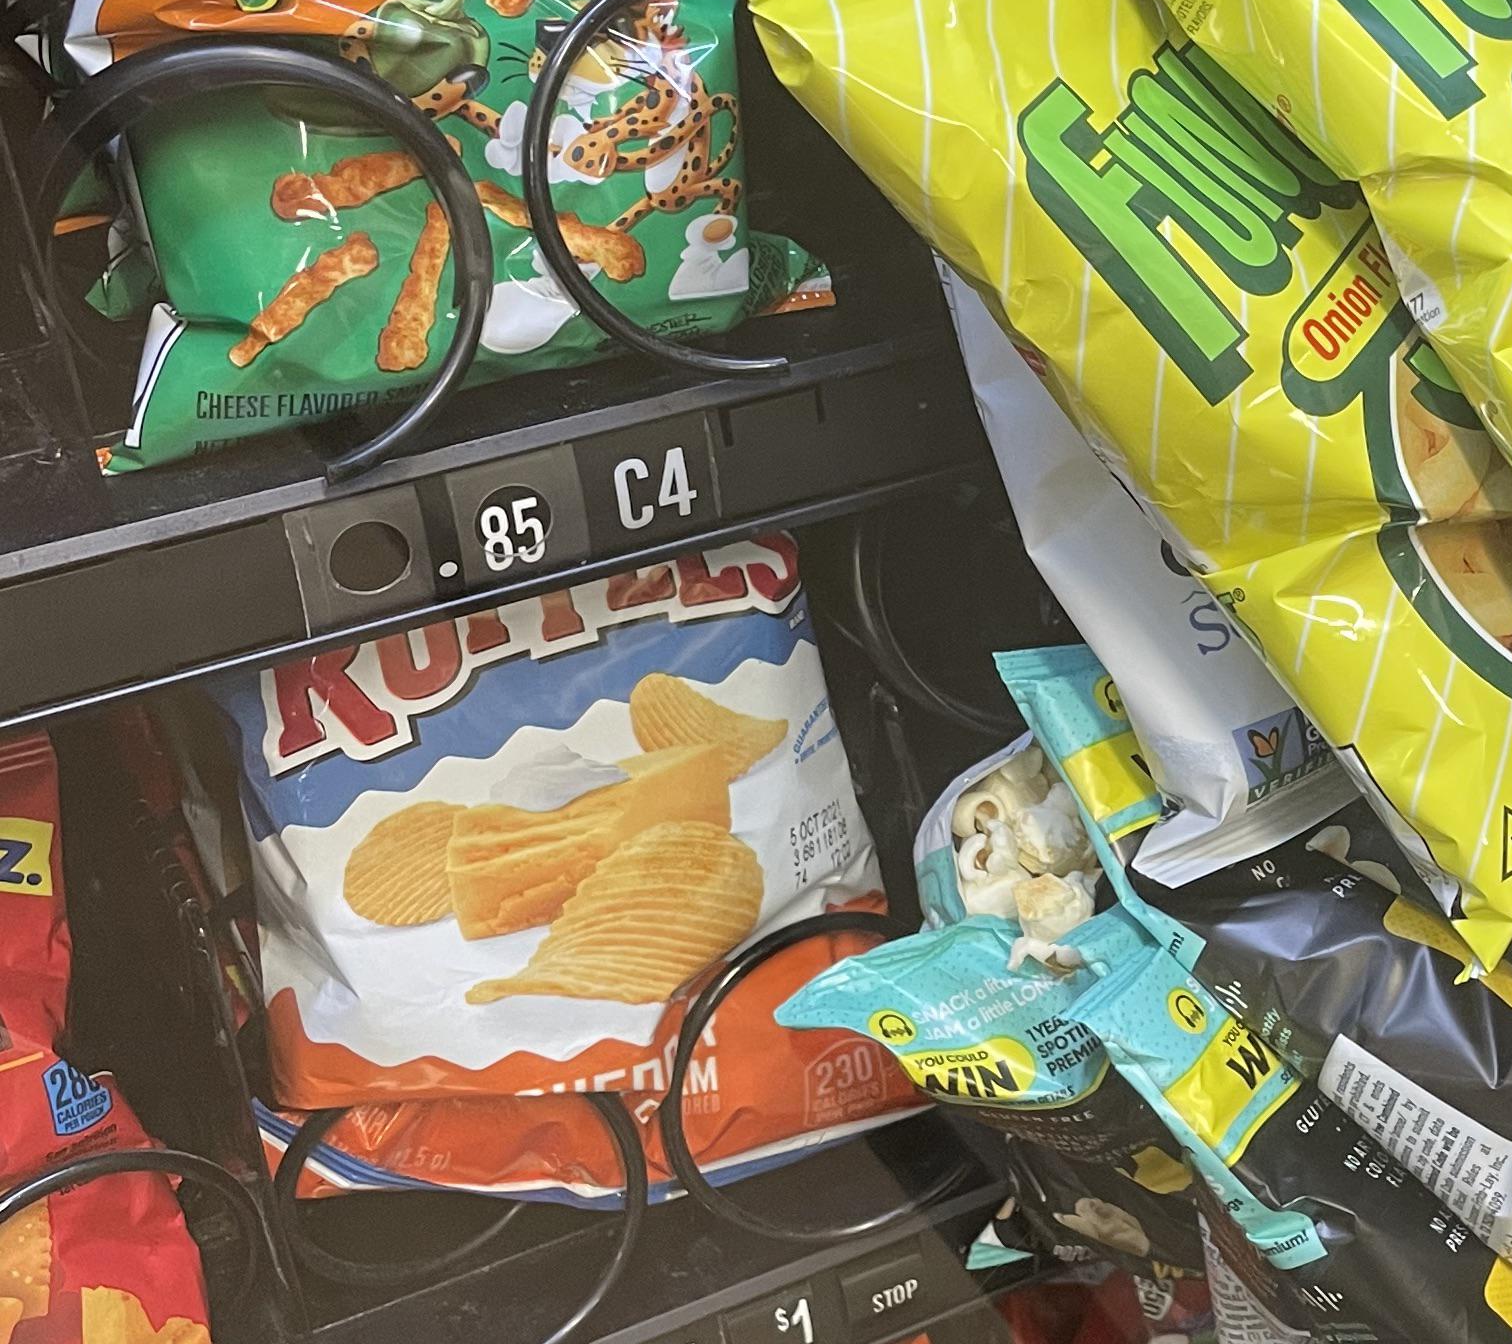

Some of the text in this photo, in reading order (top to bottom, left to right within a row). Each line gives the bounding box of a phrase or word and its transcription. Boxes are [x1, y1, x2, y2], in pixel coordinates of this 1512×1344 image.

[1302, 274, 1384, 362] Onion
[196, 391, 271, 421] CHEESE
[613, 446, 699, 532] C4
[799, 812, 820, 840] OCT
[1251, 859, 1276, 881] NO
[911, 991, 978, 1025] SNACK
[926, 1000, 1013, 1041] JAM a little
[1033, 1009, 1070, 1038] YEA
[1222, 1027, 1241, 1047] YOU
[815, 1045, 874, 1096] 230
[915, 1050, 989, 1070] YOU COULD
[57, 1092, 108, 1126] CALORIES
[1344, 1146, 1361, 1172] NO
[1429, 1213, 1448, 1235] NO
[871, 1277, 920, 1314] STOP
